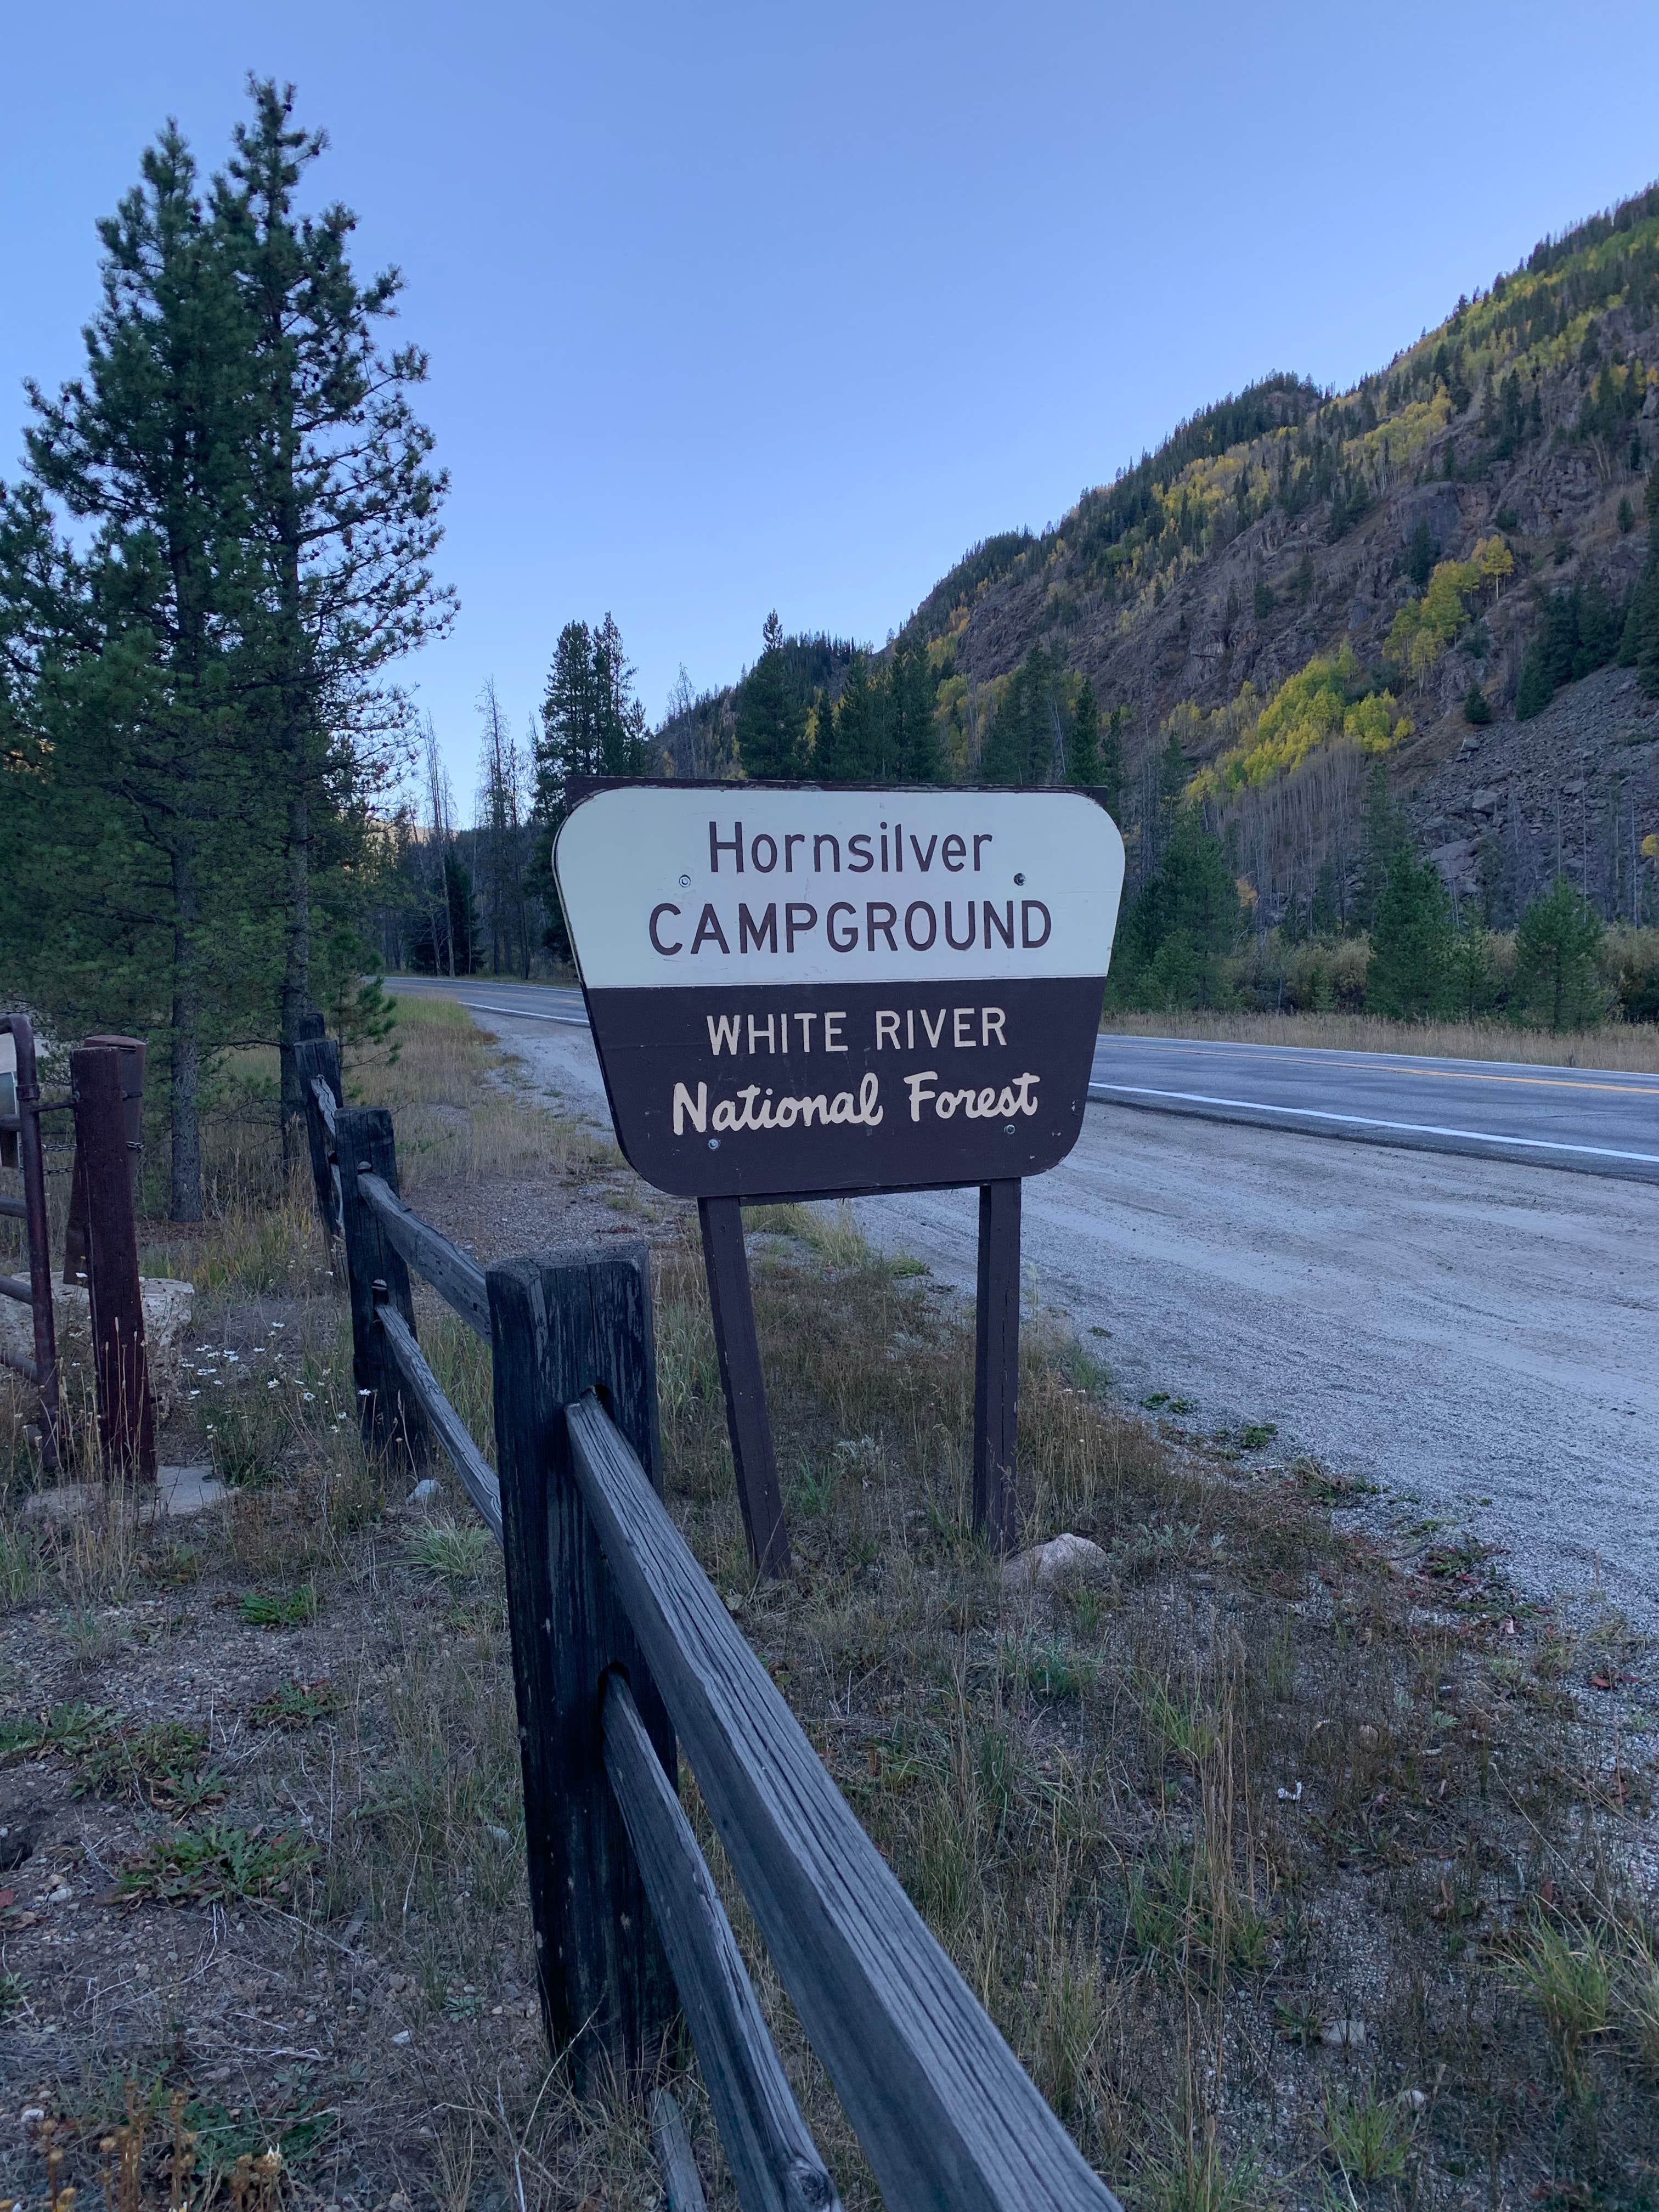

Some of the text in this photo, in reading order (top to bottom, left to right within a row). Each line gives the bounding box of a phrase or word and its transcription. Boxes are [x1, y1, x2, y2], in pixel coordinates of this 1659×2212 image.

[708, 821, 992, 873] Hornsilver
[649, 900, 1051, 956] CAMPGROUND
[707, 1007, 1007, 1056] WHITE RIVER
[673, 1071, 1041, 1135] National Forest
